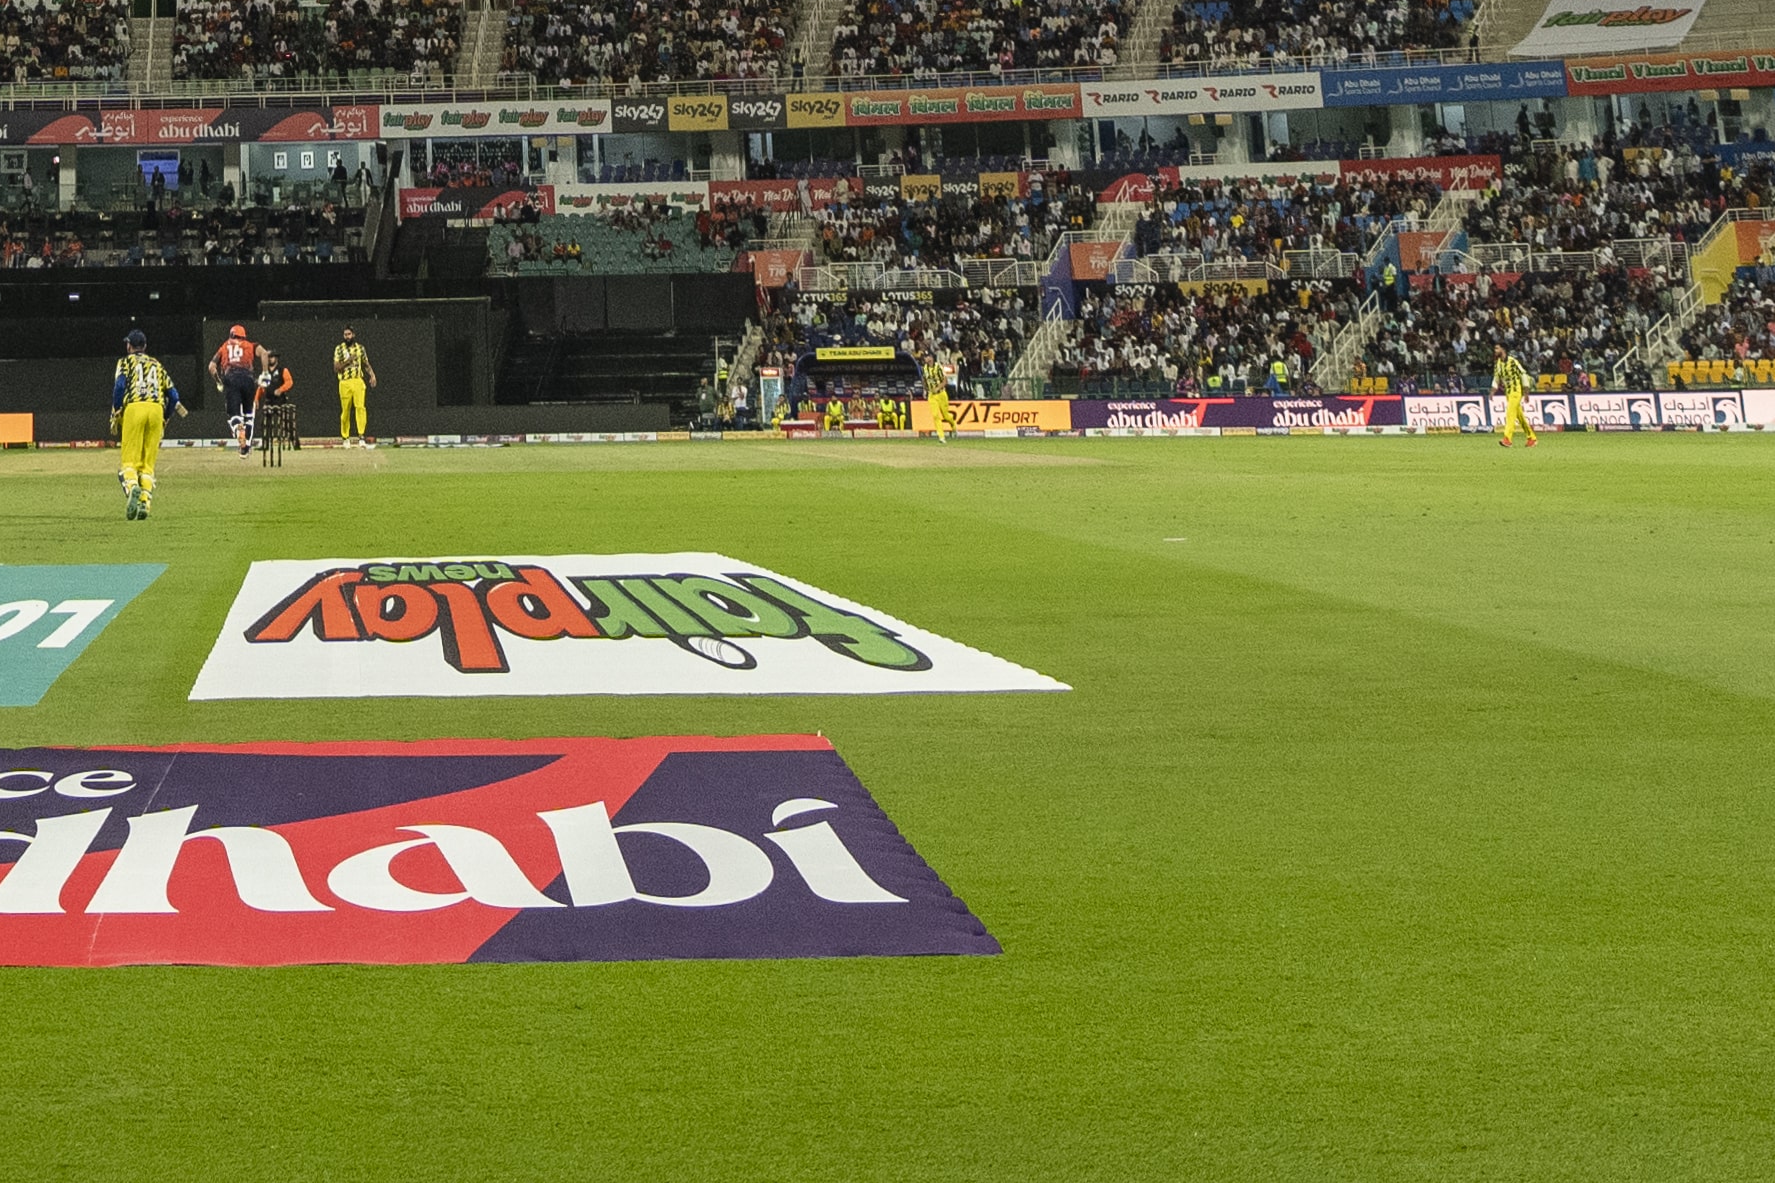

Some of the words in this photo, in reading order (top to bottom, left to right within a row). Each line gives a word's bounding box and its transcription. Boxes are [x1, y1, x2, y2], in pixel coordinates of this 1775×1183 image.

[1102, 92, 1139, 103] RARIO
[1161, 90, 1197, 101] RARIO
[1219, 88, 1256, 98] RARIO
[1278, 85, 1315, 96] RARIO
[159, 115, 203, 124] experience
[158, 124, 190, 139] abu
[193, 122, 240, 138] dhabi
[406, 201, 424, 214] abu
[427, 200, 462, 213] dhabi
[227, 344, 243, 361] 16
[135, 363, 159, 387] 14
[1107, 401, 1156, 411] experience
[1273, 399, 1323, 409] experience
[1409, 401, 1454, 415] أدنوك
[1580, 398, 1625, 413] أدنوك
[1664, 397, 1710, 412] أدنوك
[1107, 412, 1152, 428] abu
[1154, 410, 1198, 428] dhabi
[1273, 410, 1317, 427] abu
[1319, 408, 1365, 426] dhabi
[1411, 418, 1454, 426] ADNOC
[367, 562, 517, 584] news
[244, 569, 933, 674] fairplay
